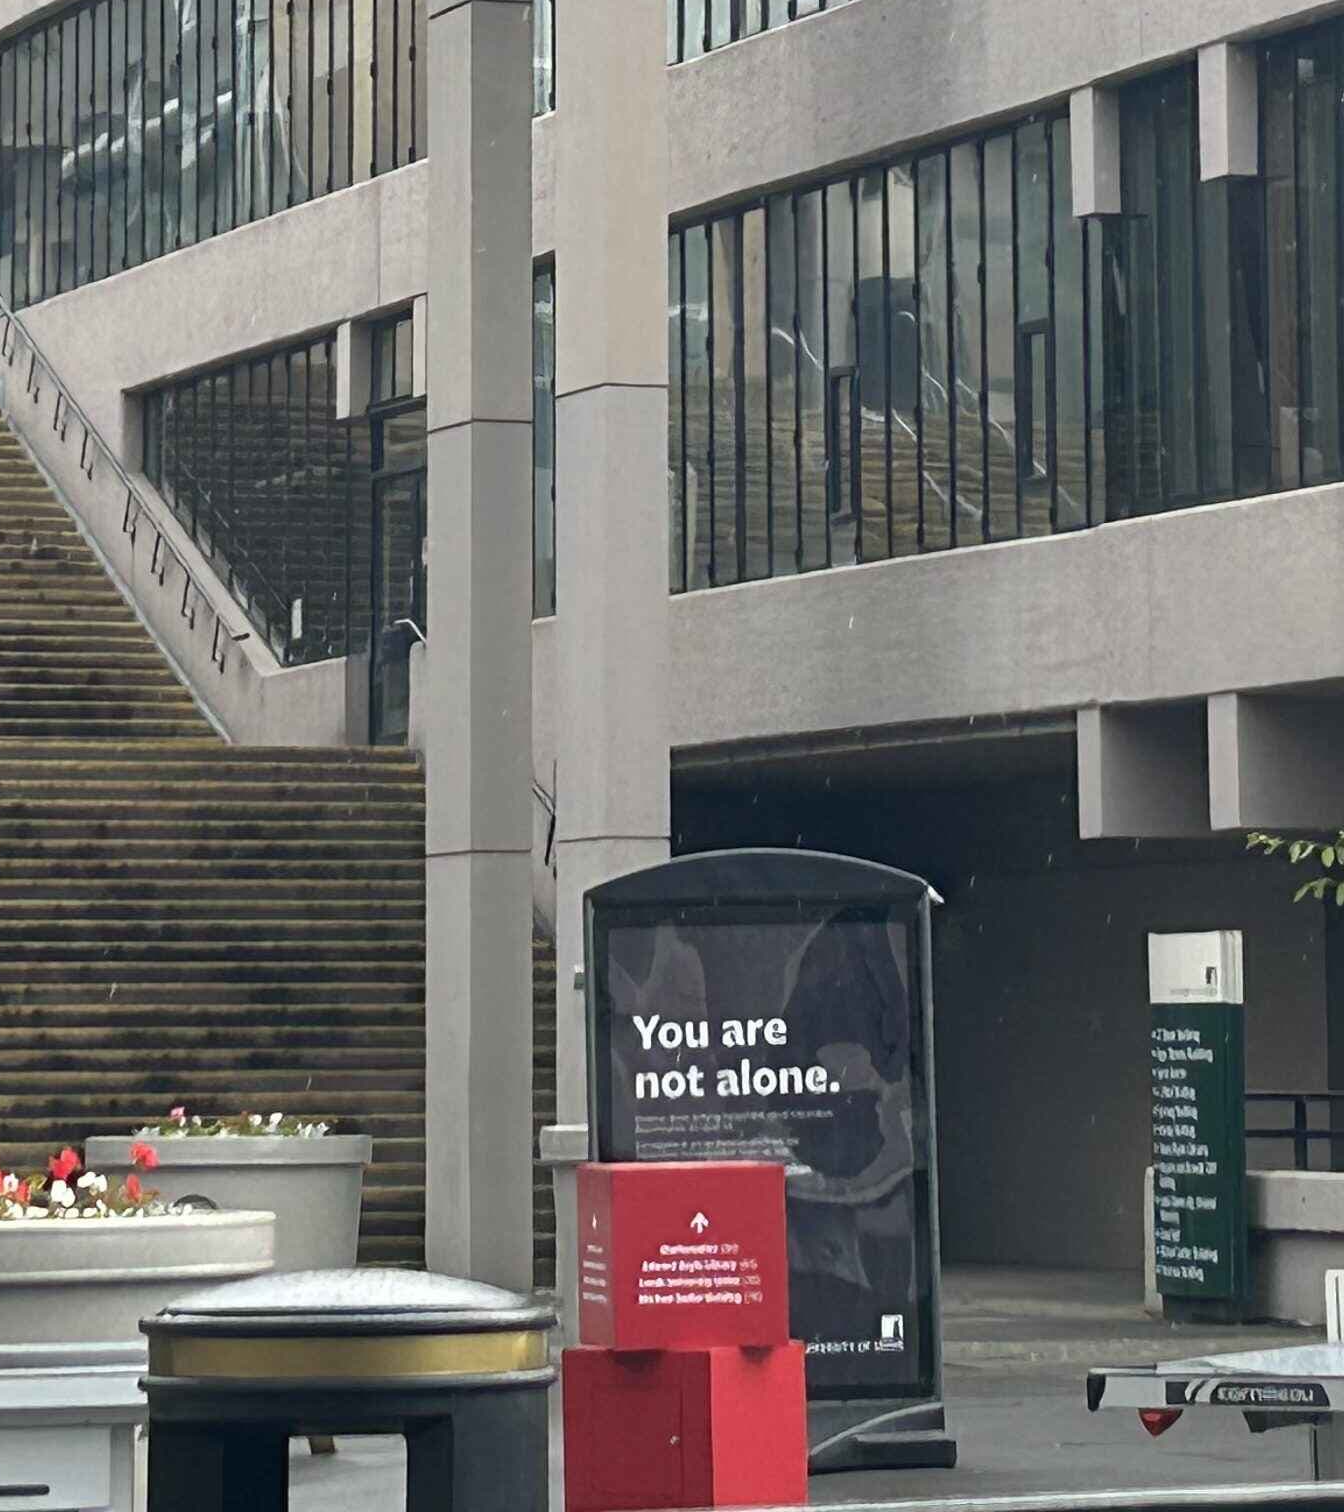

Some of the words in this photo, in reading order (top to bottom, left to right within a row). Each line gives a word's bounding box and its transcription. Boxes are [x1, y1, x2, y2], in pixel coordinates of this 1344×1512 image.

[632, 1014, 709, 1050] You
[721, 1017, 787, 1048] are
[635, 1064, 705, 1099] not
[716, 1058, 841, 1097] alone.
